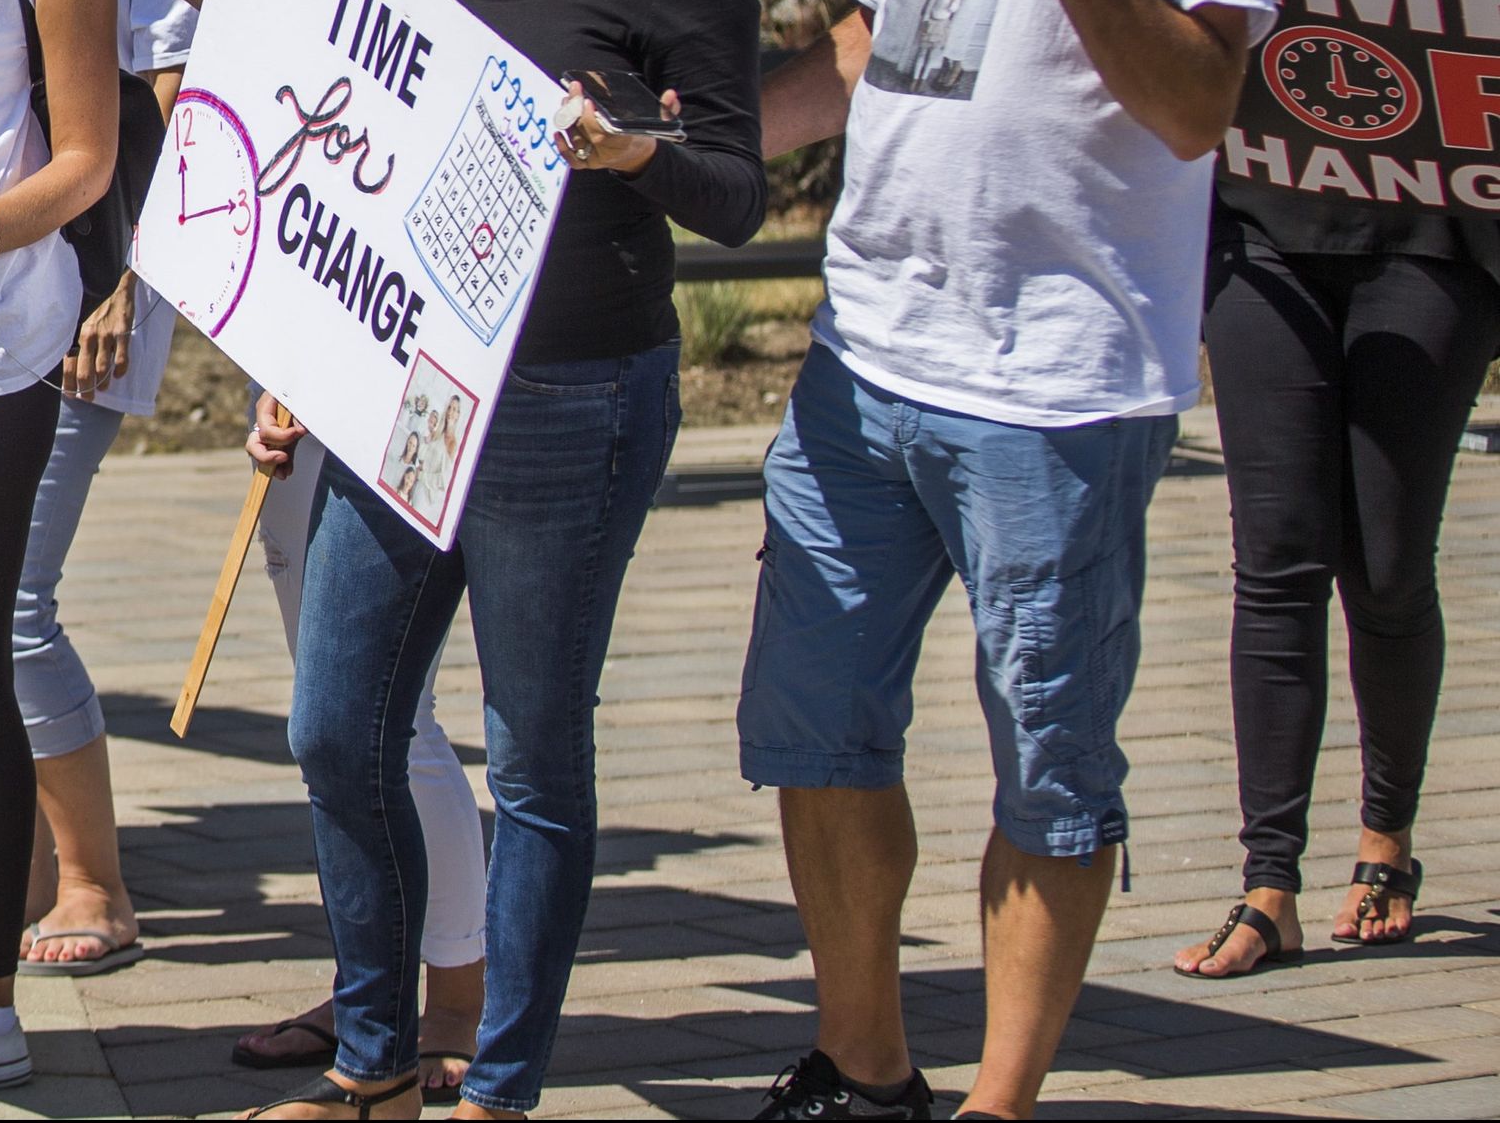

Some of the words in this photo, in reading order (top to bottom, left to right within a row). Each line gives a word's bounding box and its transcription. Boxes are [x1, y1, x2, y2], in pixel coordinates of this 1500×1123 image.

[174, 107, 196, 152] 12
[257, 76, 395, 196] for
[233, 189, 251, 236] 3
[277, 183, 426, 367] CHANGE
